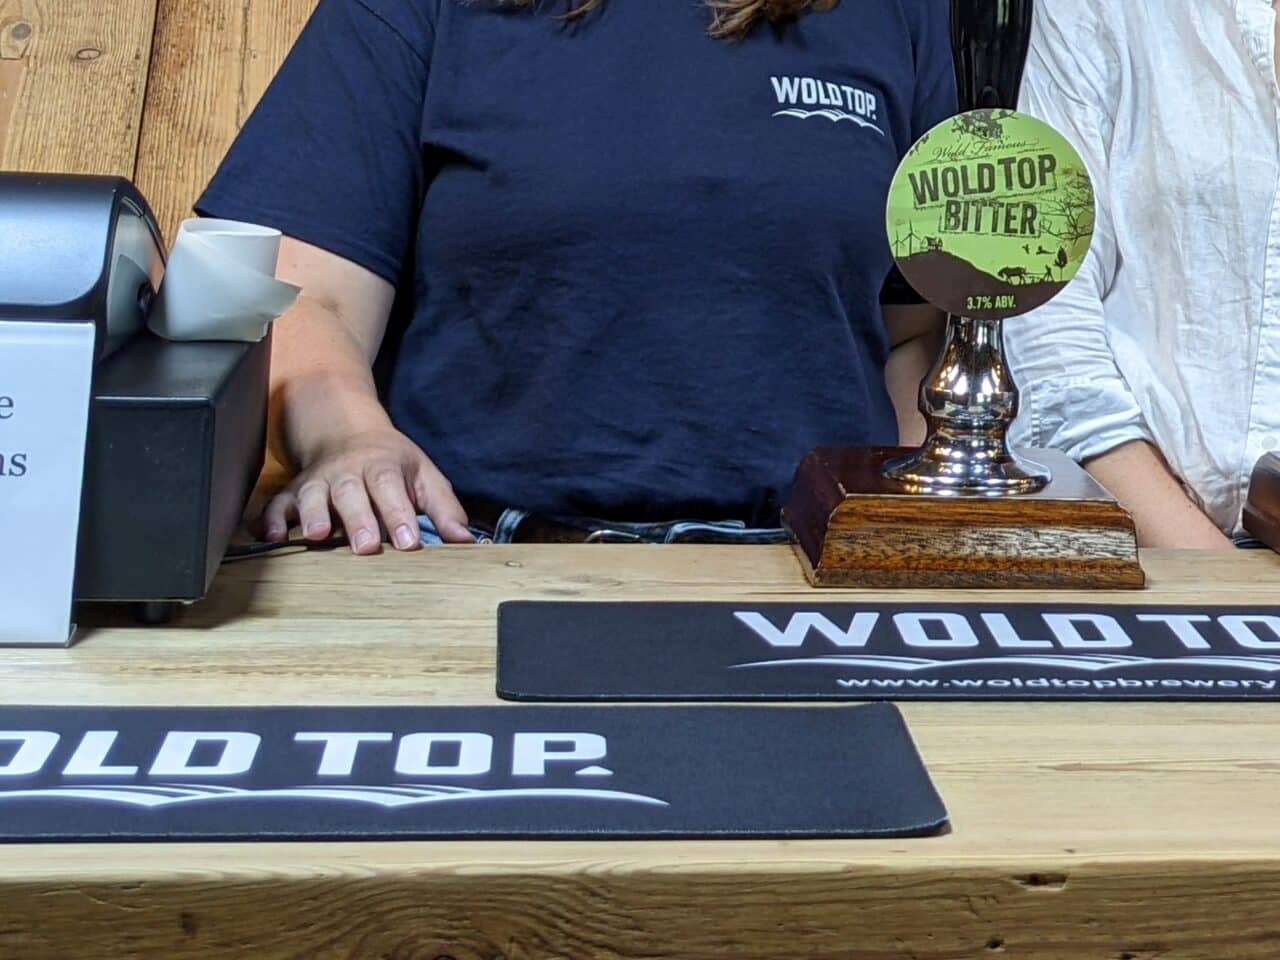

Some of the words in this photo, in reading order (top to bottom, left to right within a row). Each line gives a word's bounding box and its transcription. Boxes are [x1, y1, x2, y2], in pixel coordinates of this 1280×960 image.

[770, 76, 843, 106] WOLD
[908, 162, 995, 206] WOLD
[998, 153, 1057, 191] TOP
[943, 199, 1038, 234] BITTER
[966, 295, 993, 311] 3.7%
[732, 610, 1133, 648] WOLD
